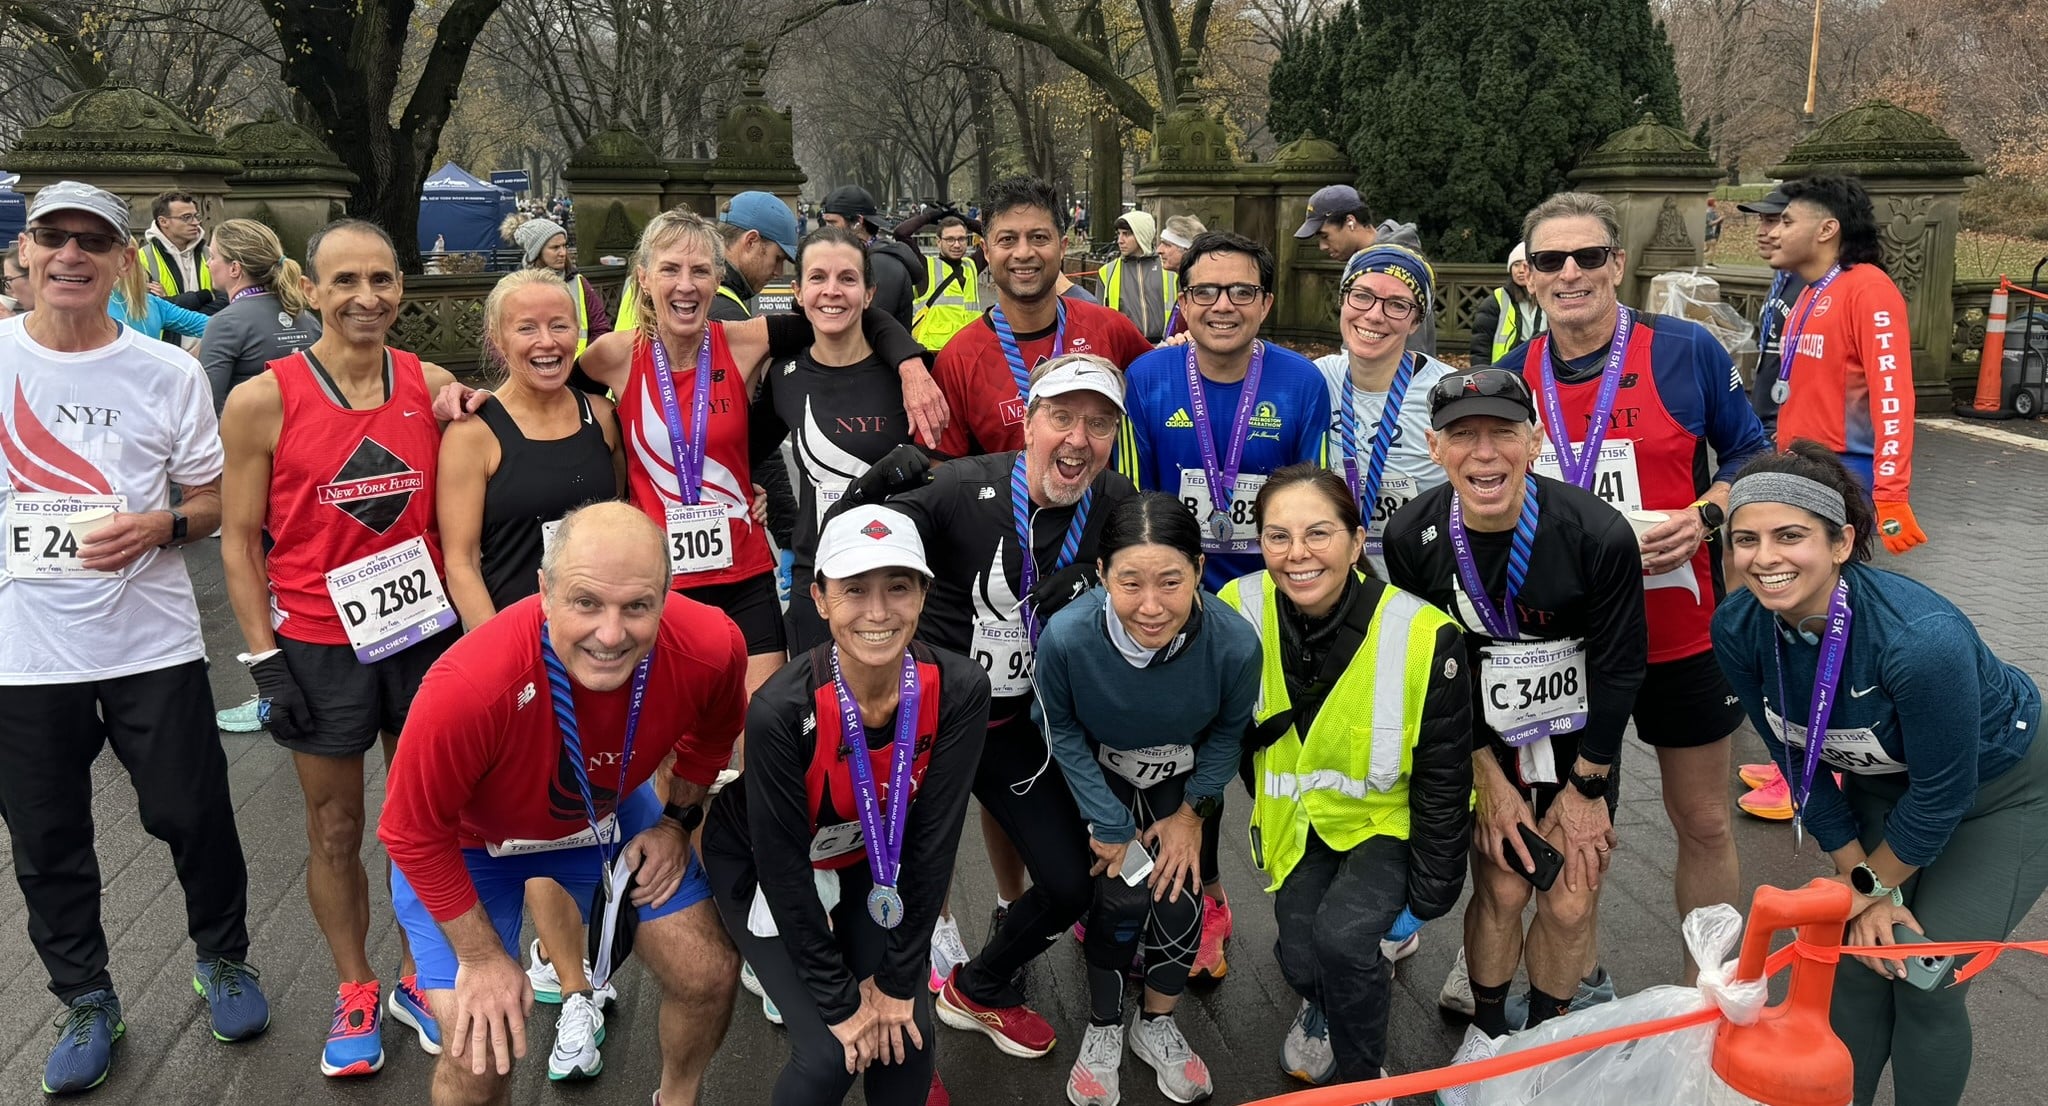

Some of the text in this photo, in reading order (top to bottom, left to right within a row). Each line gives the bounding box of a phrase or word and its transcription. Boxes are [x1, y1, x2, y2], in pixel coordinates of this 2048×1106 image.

[758, 302, 774, 310] AND
[1616, 306, 1628, 348] CORBITT
[1609, 350, 1622, 369] 15K
[654, 342, 669, 382] CORBITT
[662, 384, 673, 402] 15K
[1188, 356, 1200, 396] CORBITT
[1194, 400, 1204, 416] 15K
[1874, 310, 1900, 476] STRIDERS
[56, 404, 122, 426] NYF
[1007, 404, 1024, 420] NE
[835, 416, 888, 434] NYF
[1165, 420, 1194, 428] adidas
[1248, 420, 1282, 428] MARATHON
[1539, 454, 1558, 462] TED
[325, 477, 421, 500] NEW YORK FLYERS
[822, 492, 840, 500] TED
[15, 503, 40, 512] TED
[1184, 496, 1198, 518] B
[14, 526, 30, 553] E
[671, 528, 724, 562] 3105
[1454, 534, 1466, 554] 15K
[334, 574, 356, 588] TED
[342, 568, 432, 628] D 2382
[982, 628, 1001, 638] TED
[1832, 612, 1846, 636] 15K
[368, 618, 441, 658] BAG CHECK 2382
[1491, 656, 1510, 665] TED
[1824, 644, 1837, 682] 12.02.2023
[904, 664, 915, 689] 15K
[632, 684, 644, 710] 15K
[1490, 666, 1578, 711] C 3408
[900, 698, 912, 740] 12.02.2023
[1516, 727, 1539, 740] CHECK
[1550, 717, 1572, 731] 3408
[1107, 752, 1177, 780] C 779
[844, 705, 858, 732] 15K
[852, 738, 866, 778] 12.02.2023
[872, 839, 880, 855] ROAD
[827, 824, 852, 833] TED
[816, 837, 838, 852] C
